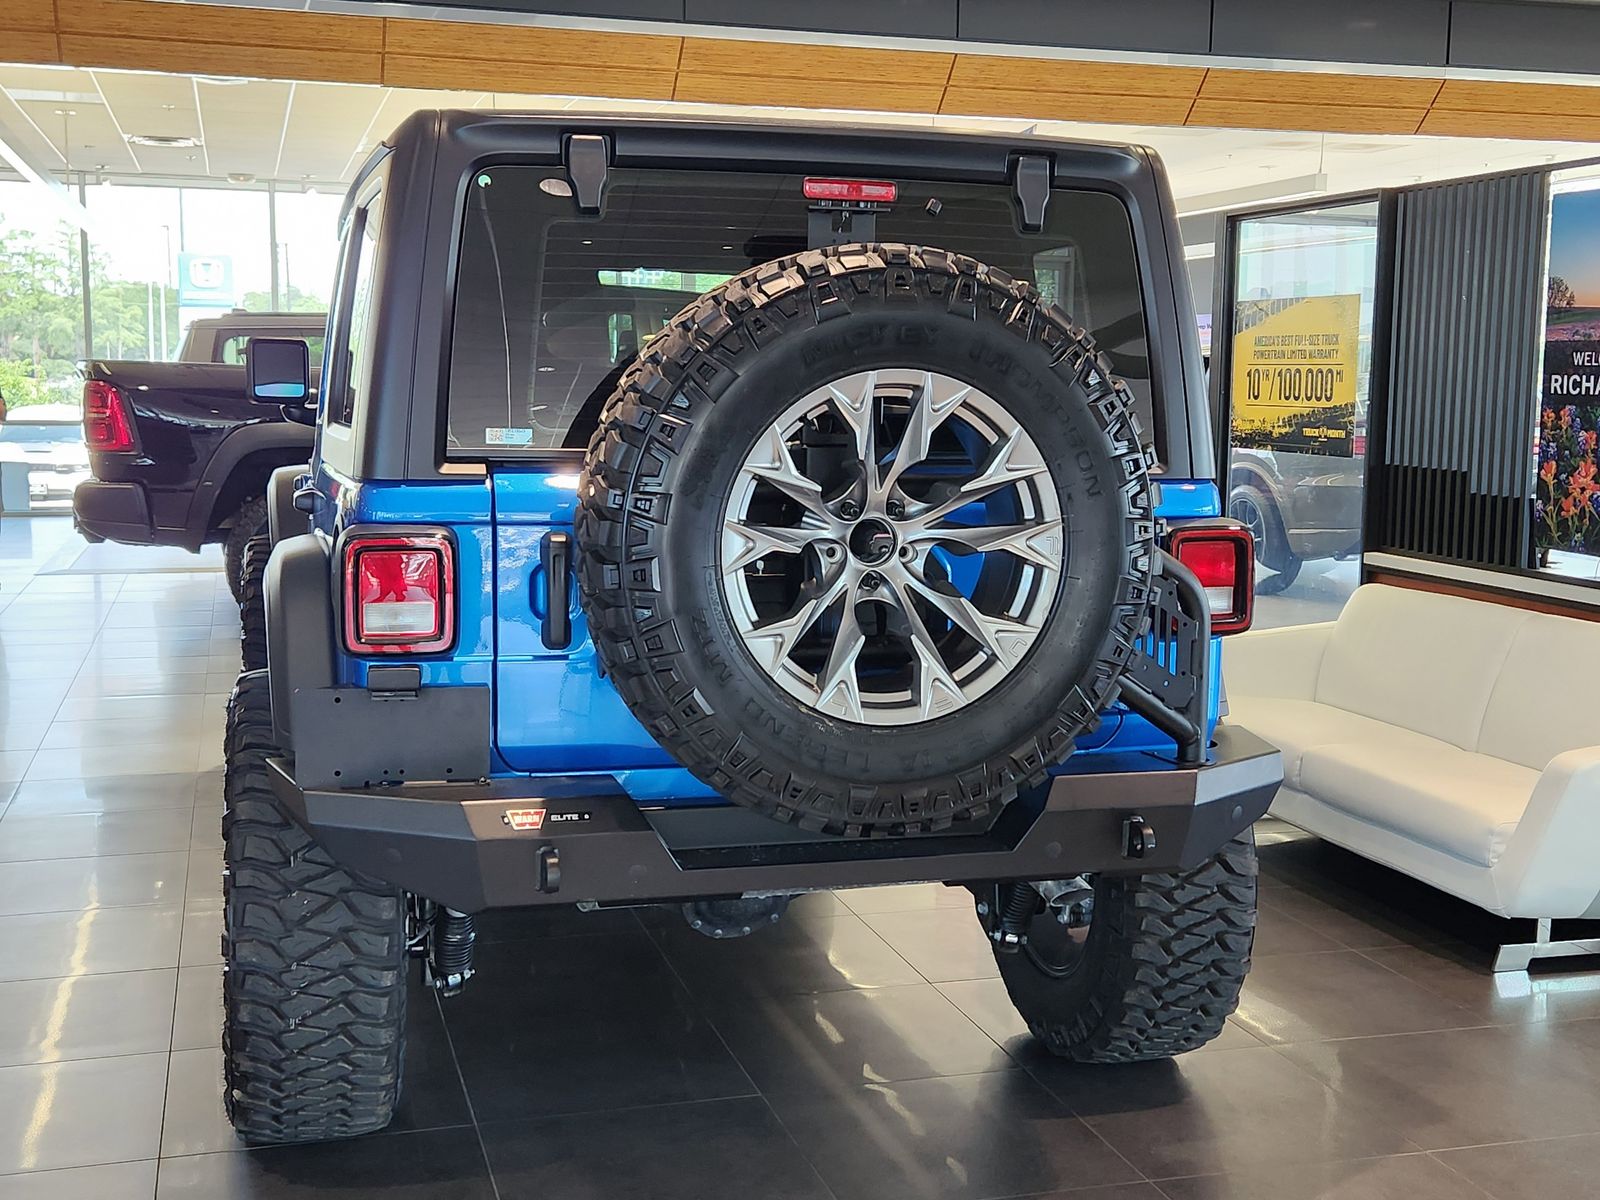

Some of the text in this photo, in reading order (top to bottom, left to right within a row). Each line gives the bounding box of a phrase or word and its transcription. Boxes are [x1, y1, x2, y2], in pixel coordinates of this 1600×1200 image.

[1281, 335, 1294, 346] BEST
[1295, 334, 1320, 346] FULL-SIZE
[1322, 334, 1339, 345] TRUCK
[1253, 349, 1338, 359] POWERTRAIN LIMITED WARRANTY
[1573, 352, 1600, 366] WEL
